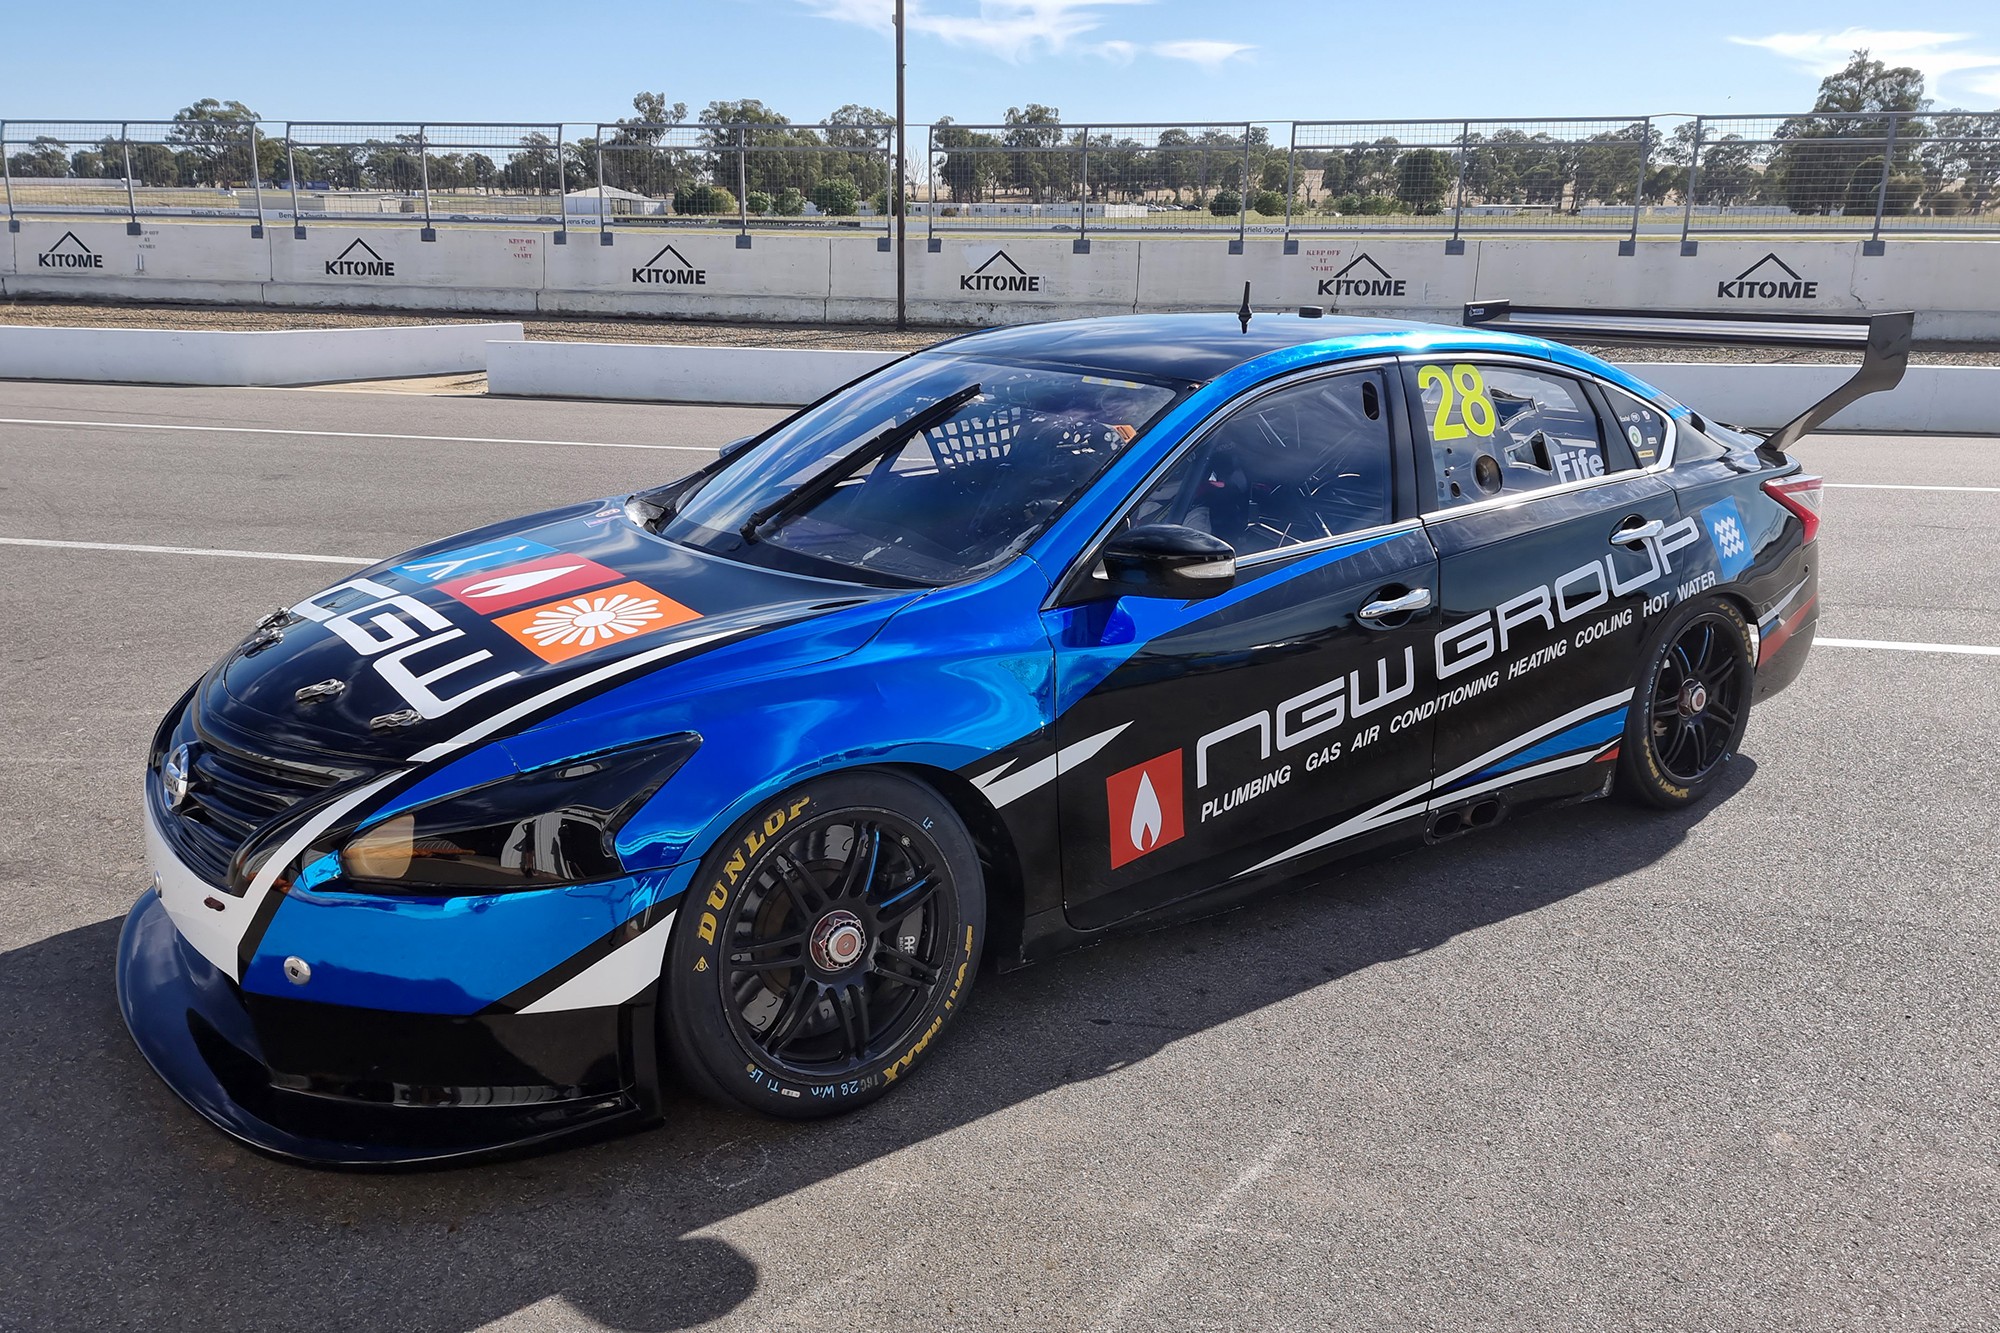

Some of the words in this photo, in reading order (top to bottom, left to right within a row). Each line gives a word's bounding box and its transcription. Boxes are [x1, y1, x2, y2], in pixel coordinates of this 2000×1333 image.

[38, 253, 103, 269] KITOME
[325, 260, 395, 276] KITOME
[632, 268, 706, 285] KITOME
[960, 275, 1039, 291] KITOME
[1317, 279, 1406, 296] KITOME
[1717, 281, 1818, 299] KITOME
[1418, 363, 1496, 441] 28
[1553, 449, 1605, 485] Fife
[1436, 516, 1699, 680] GROUP
[1201, 764, 1290, 823] PLUMBING
[1305, 741, 1341, 772] GAS
[1351, 724, 1379, 753] AIR
[1389, 670, 1499, 736] CONDITIONING
[1508, 638, 1567, 679] HEATING
[1574, 607, 1632, 649] COOLING
[1643, 591, 1669, 617] HOT
[1676, 570, 1716, 602] WATER
[922, 816, 934, 830] LF
[698, 795, 811, 945] DUNLOP
[749, 1067, 764, 1083] LF
[811, 1084, 835, 1098] Win
[840, 1080, 859, 1096] 28
